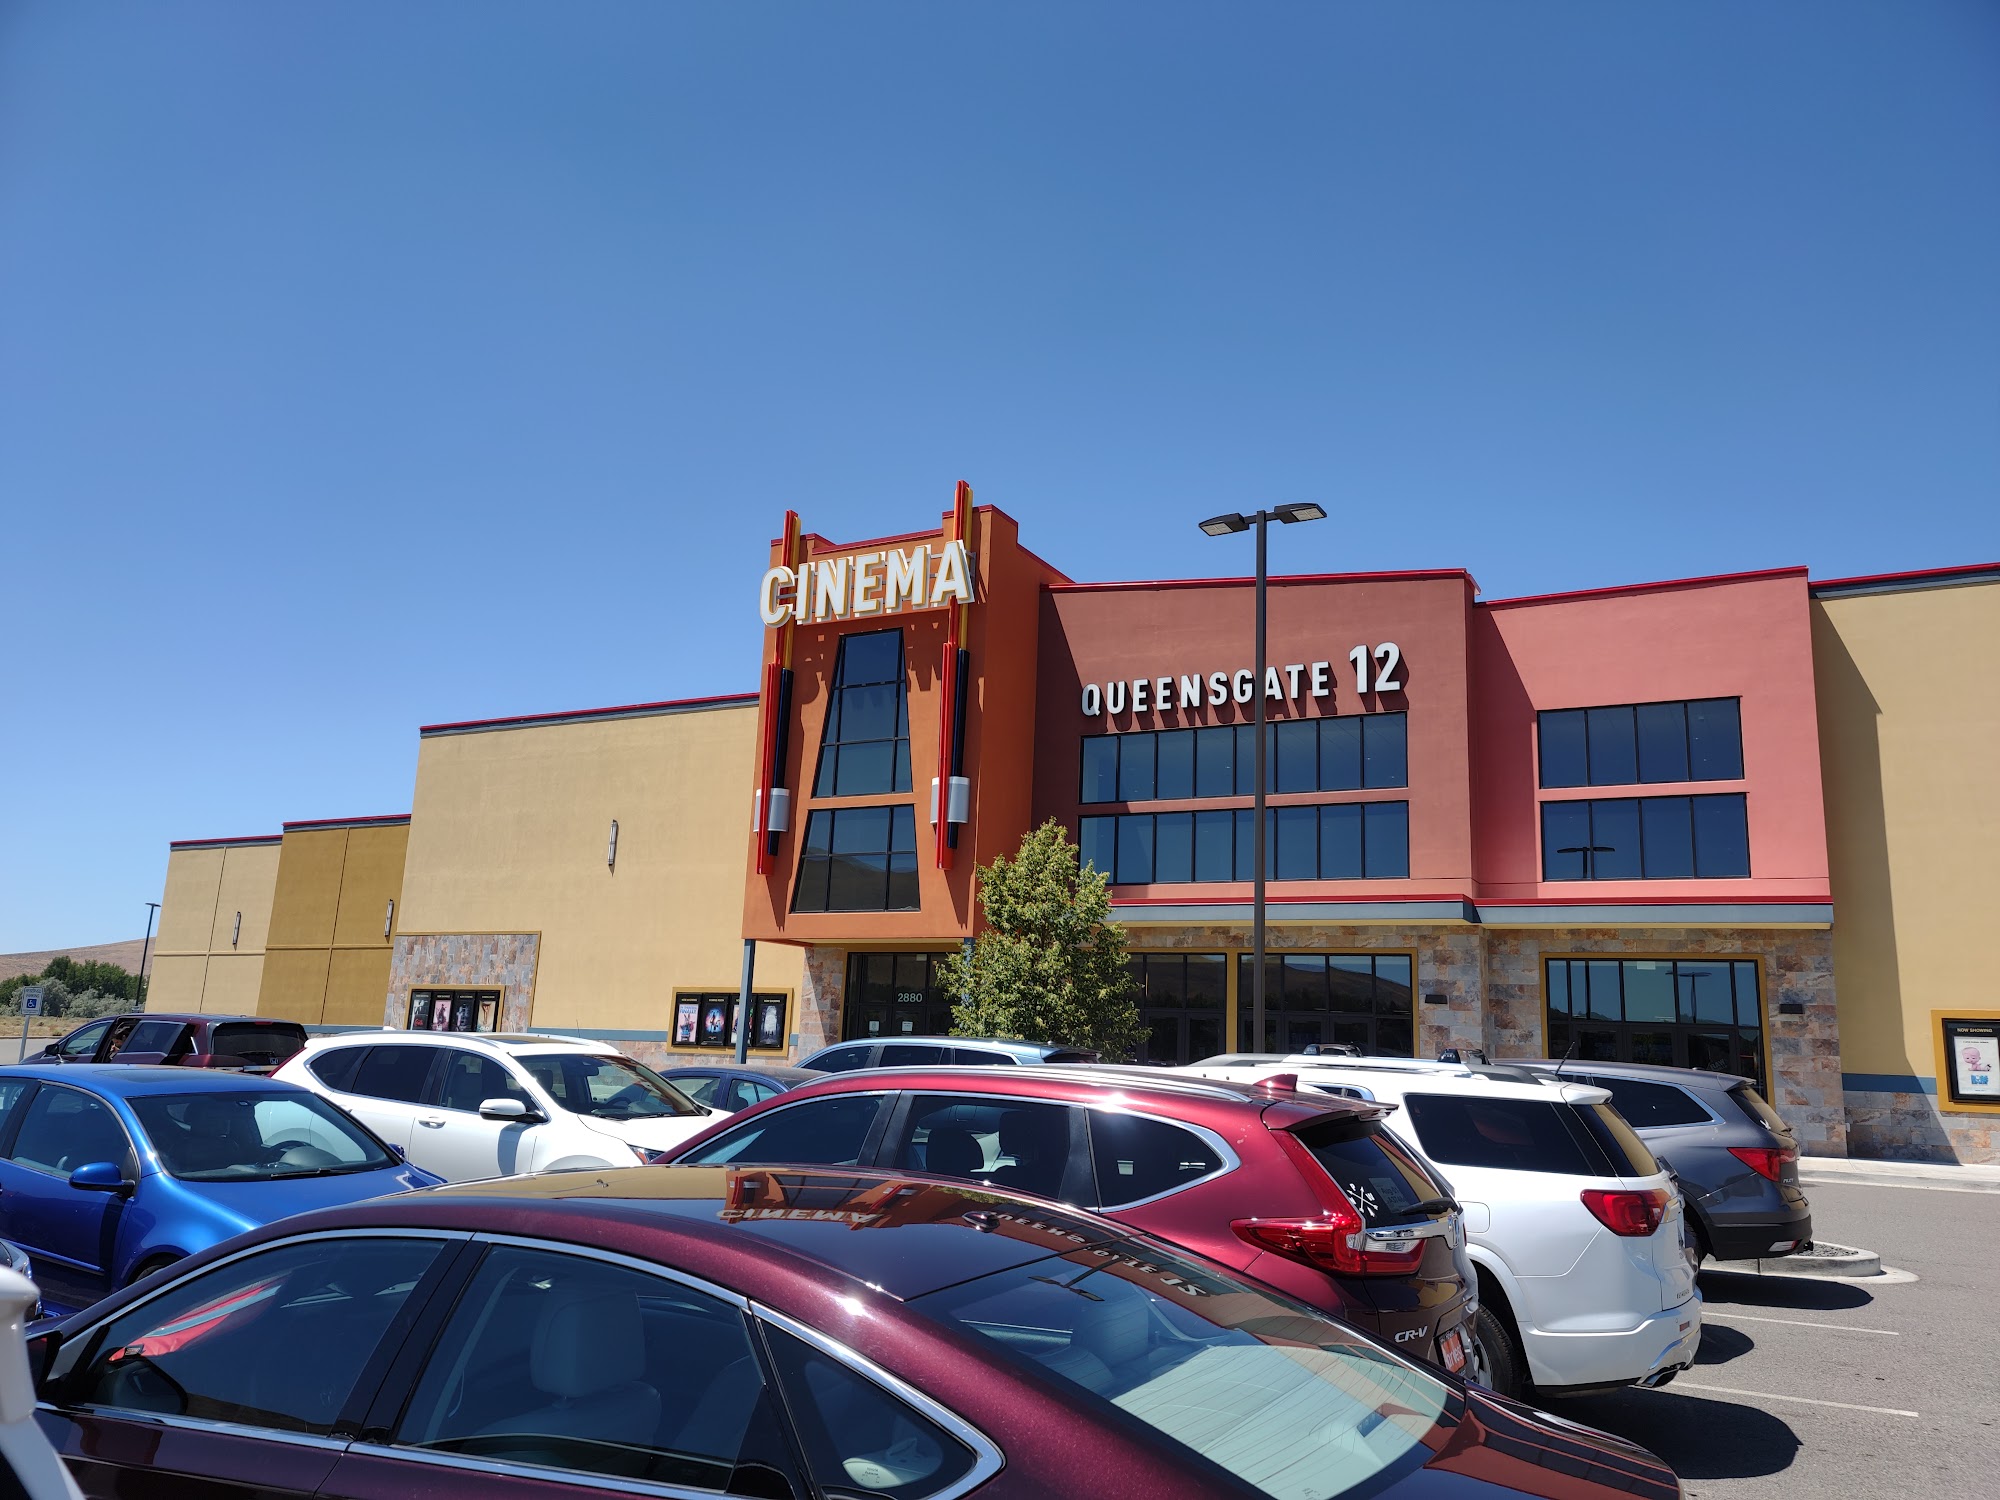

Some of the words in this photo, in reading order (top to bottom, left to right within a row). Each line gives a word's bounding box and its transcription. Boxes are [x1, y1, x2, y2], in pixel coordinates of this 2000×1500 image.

[759, 539, 976, 628] CINEMA
[1081, 660, 1330, 717] QUEENSGATE
[1349, 642, 1402, 695] 12
[897, 992, 923, 1003] 2880
[1394, 1325, 1428, 1343] CR-V
